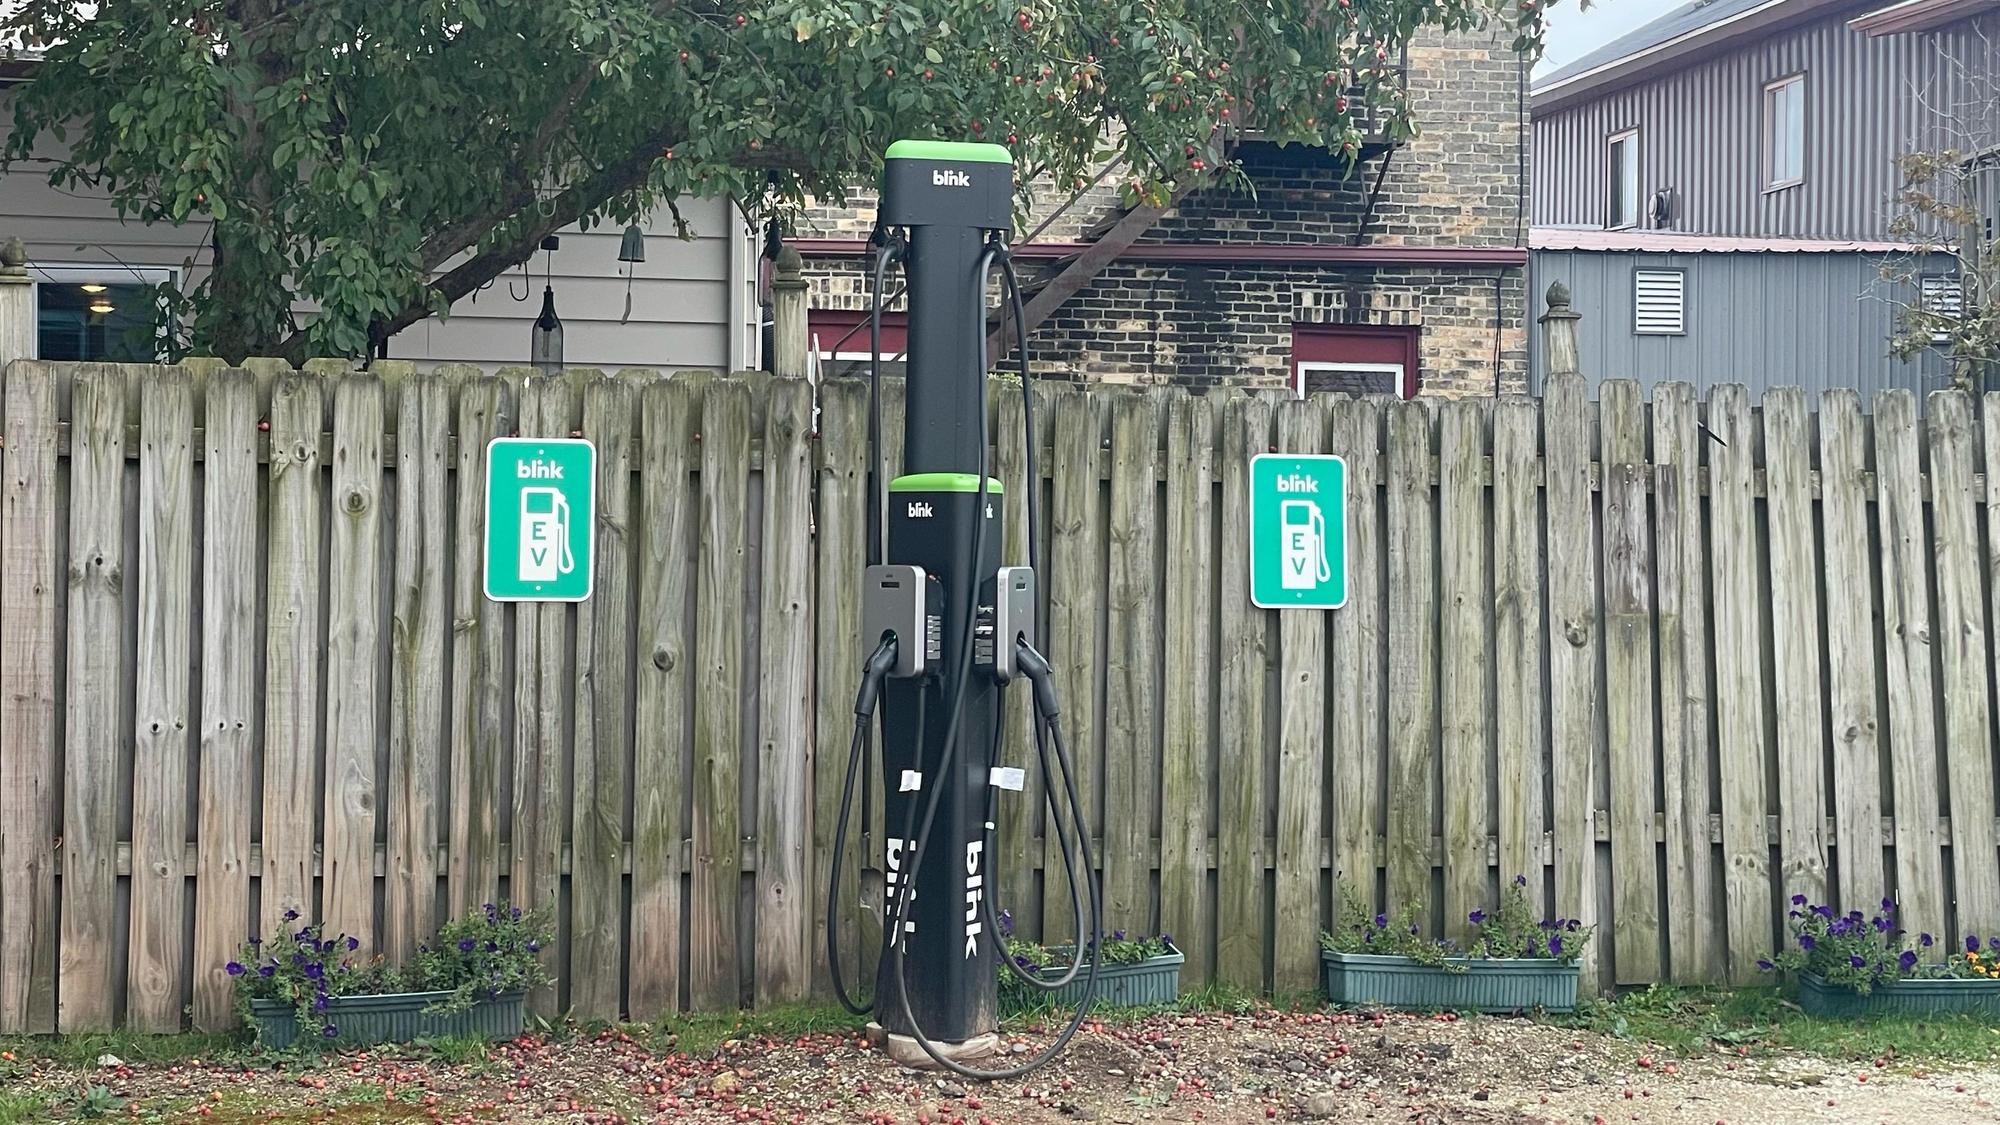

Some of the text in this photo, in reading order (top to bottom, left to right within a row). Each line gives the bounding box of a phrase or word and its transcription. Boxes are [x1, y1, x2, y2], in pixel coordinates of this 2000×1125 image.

[933, 170, 970, 186] blink
[517, 459, 564, 479] blink
[1277, 474, 1319, 493] blink
[908, 502, 933, 518] blink
[965, 840, 983, 960] blink
